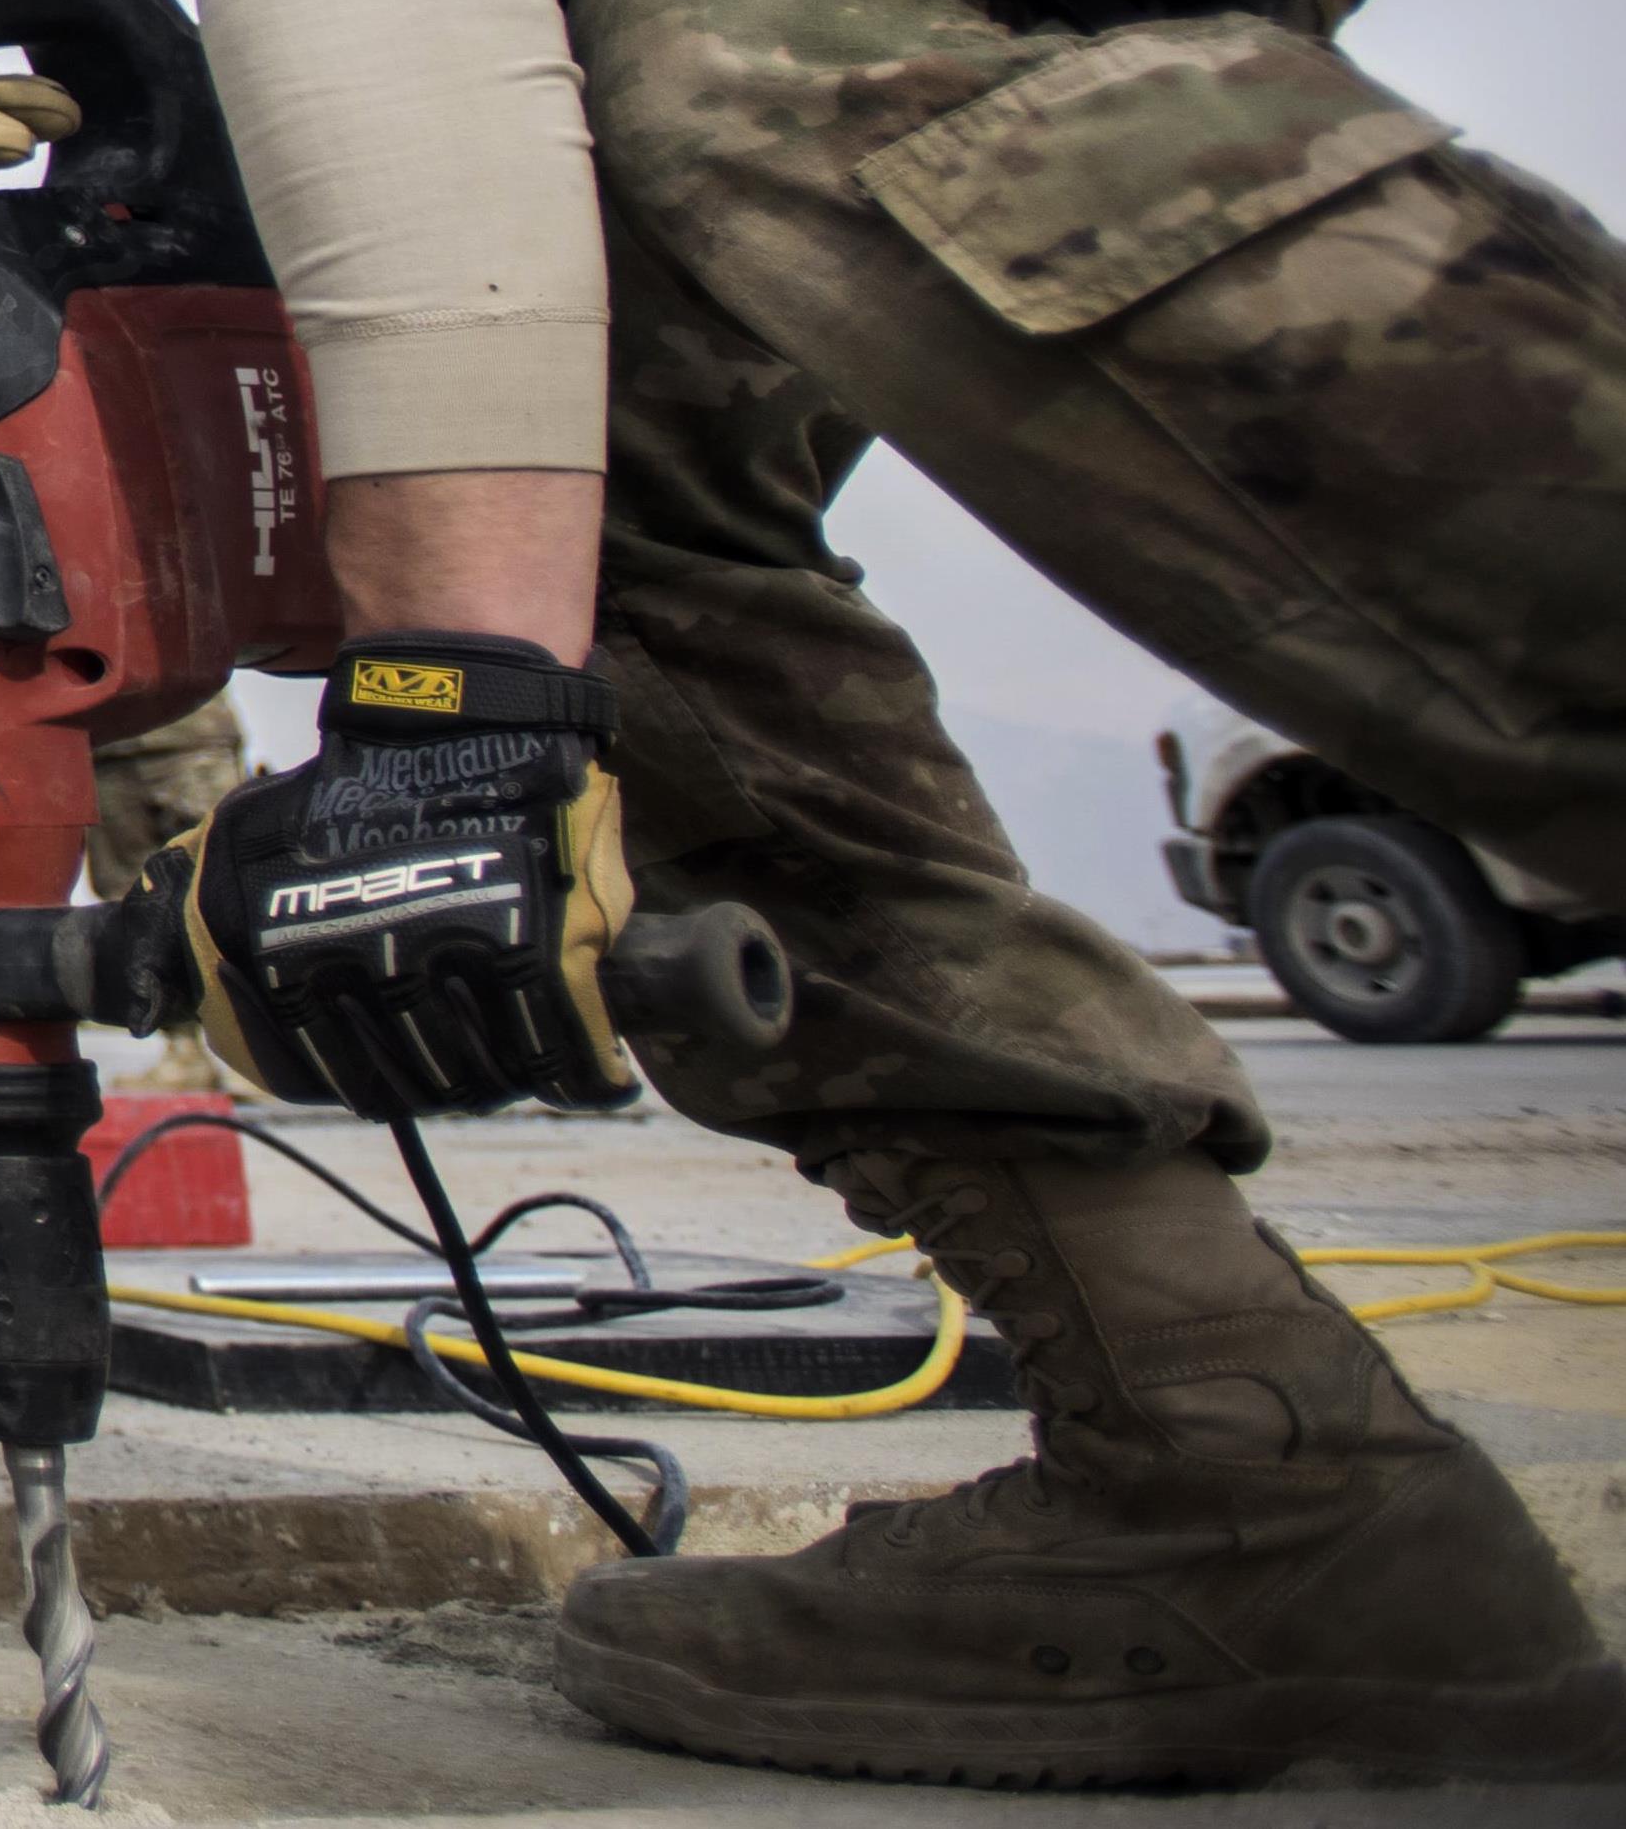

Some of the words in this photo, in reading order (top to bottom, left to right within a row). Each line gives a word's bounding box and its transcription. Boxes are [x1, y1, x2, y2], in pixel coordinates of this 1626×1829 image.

[263, 369, 288, 422] ATC
[235, 368, 275, 576] HILTI
[279, 488, 296, 523] TE
[269, 851, 503, 918] MPACT
